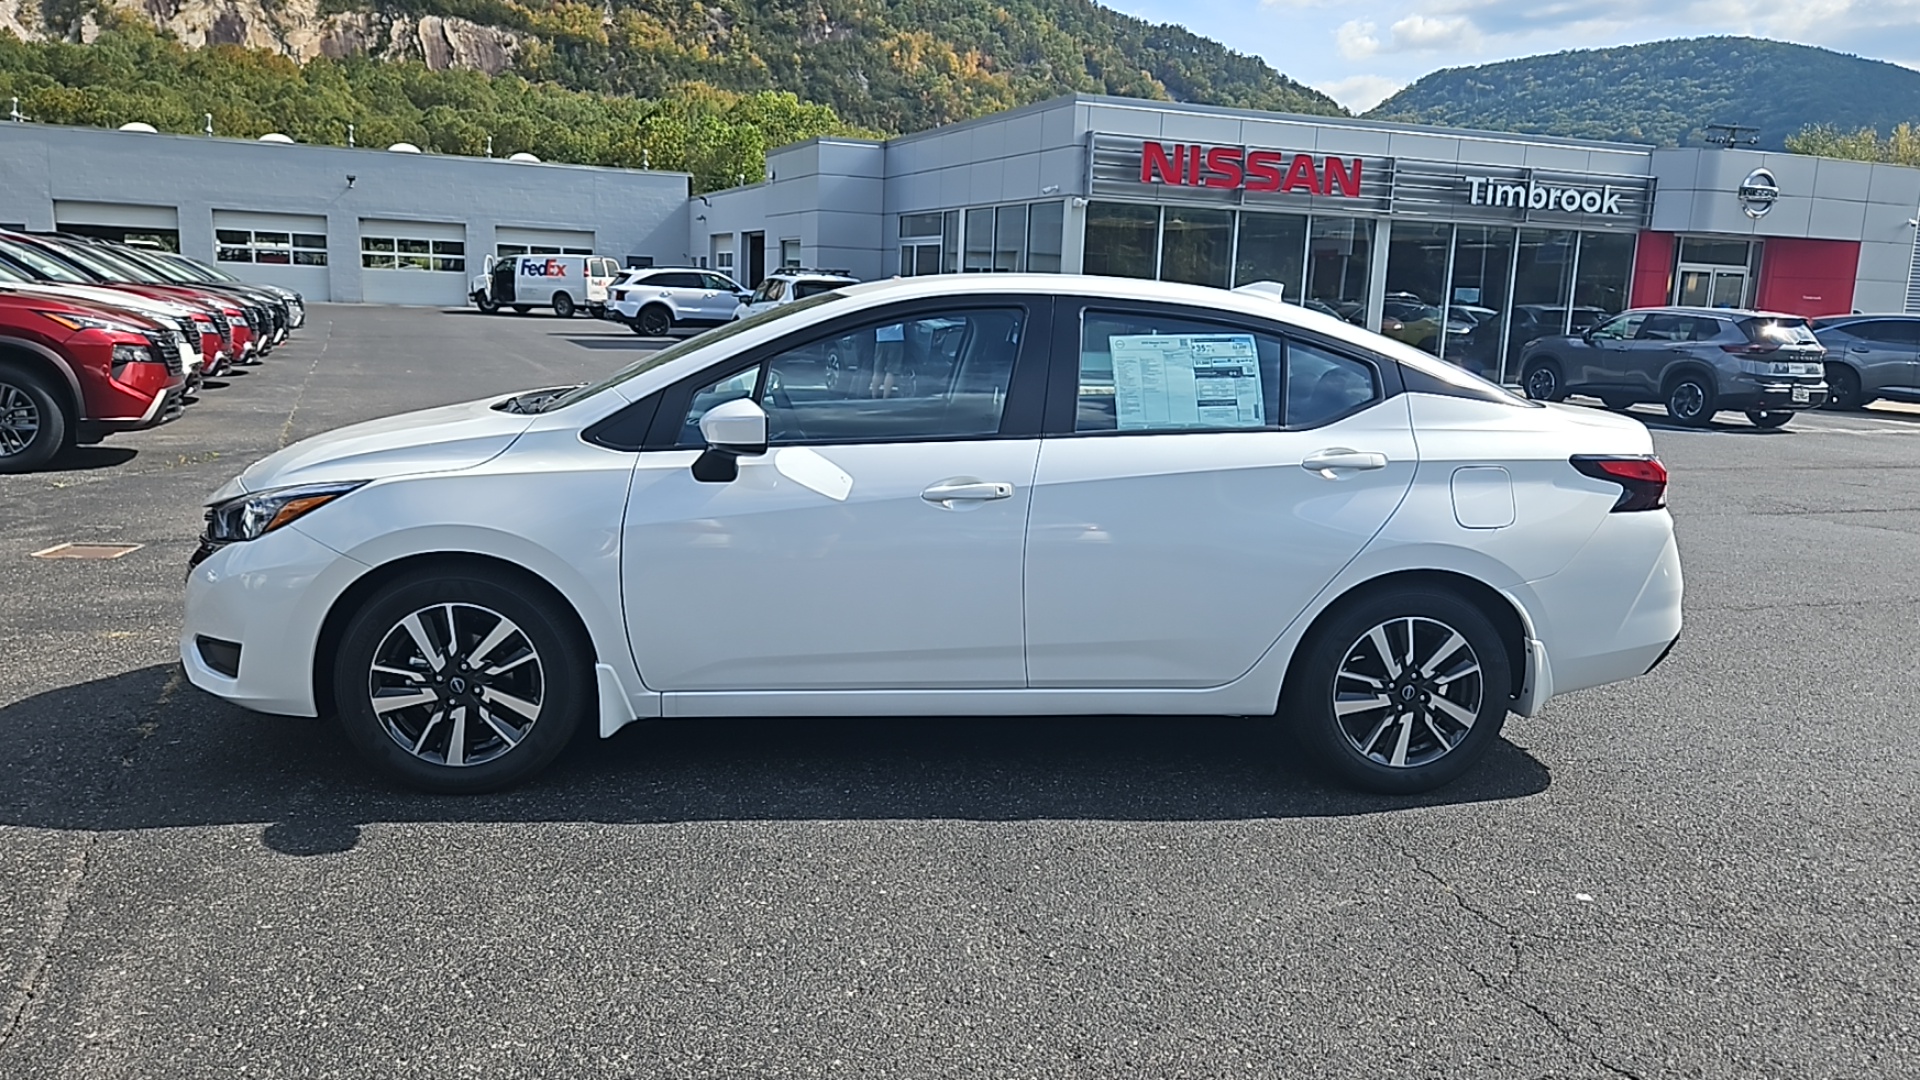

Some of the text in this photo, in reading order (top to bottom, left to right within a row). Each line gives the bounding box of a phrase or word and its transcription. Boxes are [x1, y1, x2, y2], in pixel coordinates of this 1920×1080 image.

[1141, 141, 1362, 198] NISSAN
[1465, 176, 1621, 214] Timbrook
[521, 259, 567, 277] FedEx
